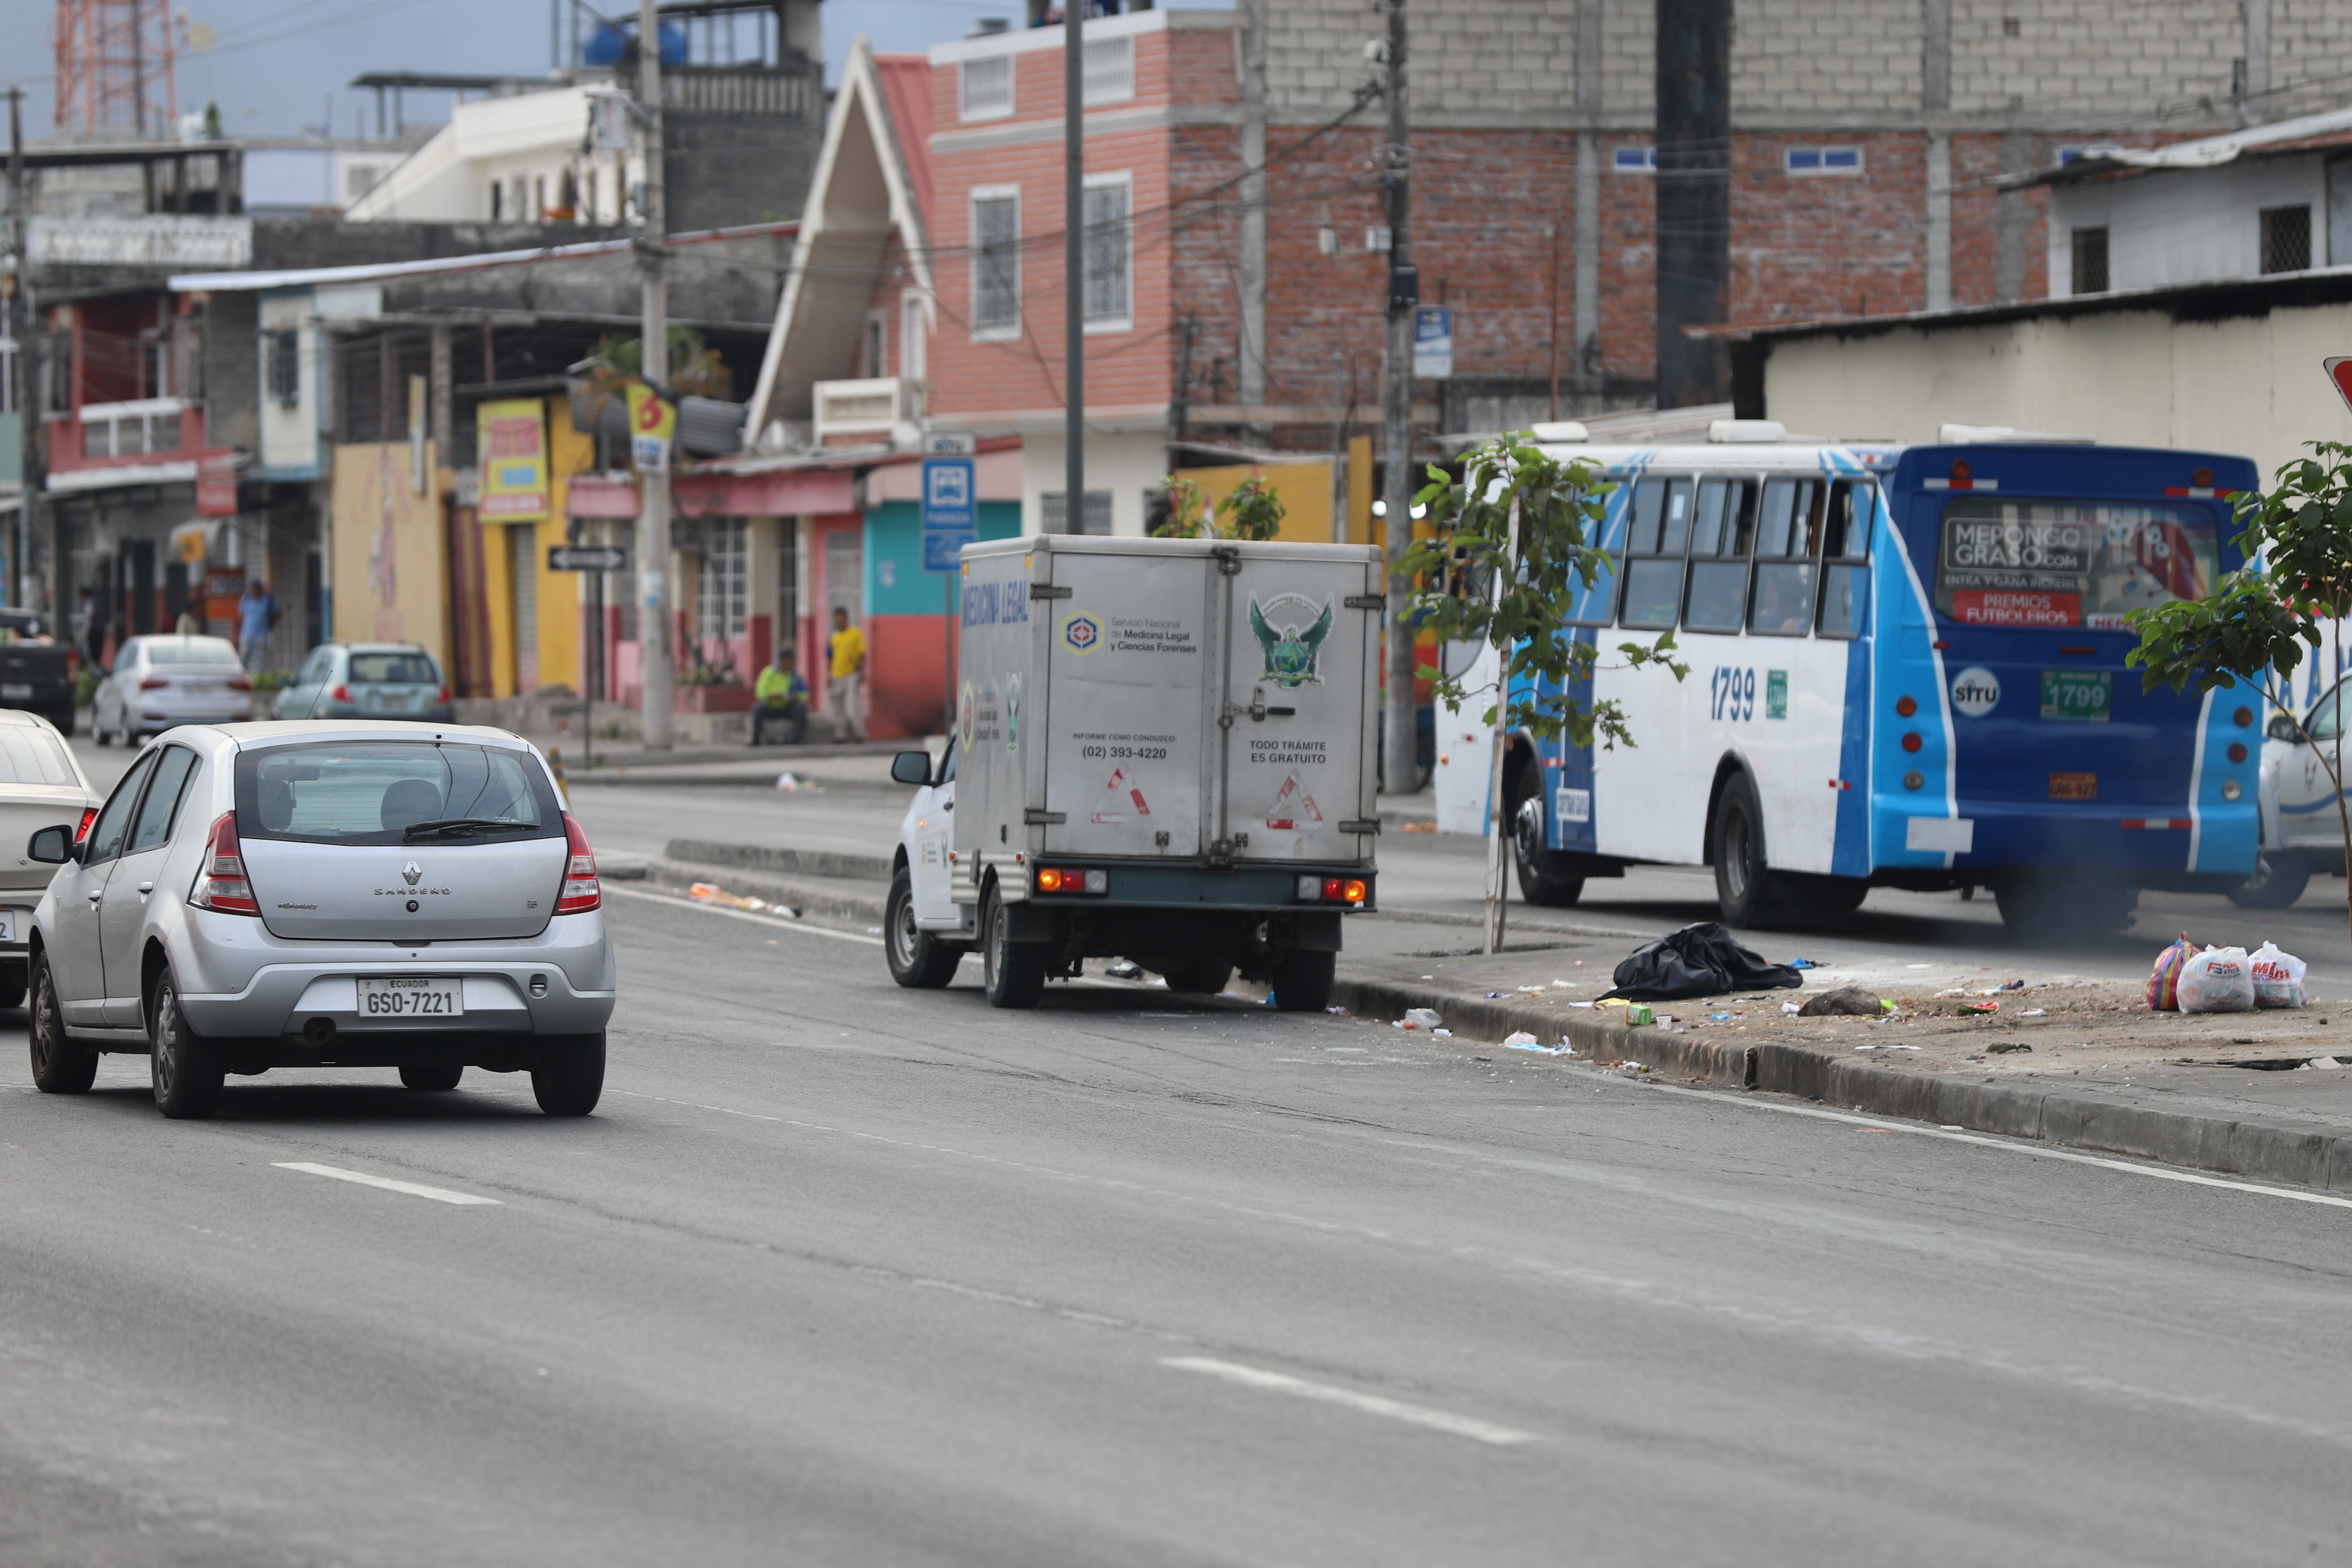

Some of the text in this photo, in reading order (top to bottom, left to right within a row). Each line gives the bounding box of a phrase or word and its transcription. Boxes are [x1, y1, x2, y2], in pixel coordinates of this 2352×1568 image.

[1955, 524, 2081, 549] MEPONGO
[1946, 574, 1981, 586] ENTRA
[1984, 575, 1992, 586] Y
[1994, 576, 2028, 586] GANA
[963, 579, 1028, 627] MEDICINA LEGAL
[1983, 593, 2051, 610] PREMIOS
[1111, 617, 1181, 628] Servicio Nacional
[1966, 608, 2069, 625] FUTBOLEROS
[1111, 629, 1190, 642] de Medicina Legal
[1110, 641, 1197, 653] y Ciencias Forenses
[1711, 665, 1756, 722] 1799
[2048, 684, 2105, 708] 1799
[1250, 739, 1327, 750] TODO TRÁMITE
[1082, 746, 1167, 759] (02) 393-4220
[1251, 753, 1327, 763] ES GRATUITO
[373, 887, 452, 896] SANDERO
[277, 902, 318, 910] RENAULT
[2251, 960, 2291, 979] Mini
[390, 979, 430, 988] ECUADOR
[367, 991, 453, 1014] GSO-7221
